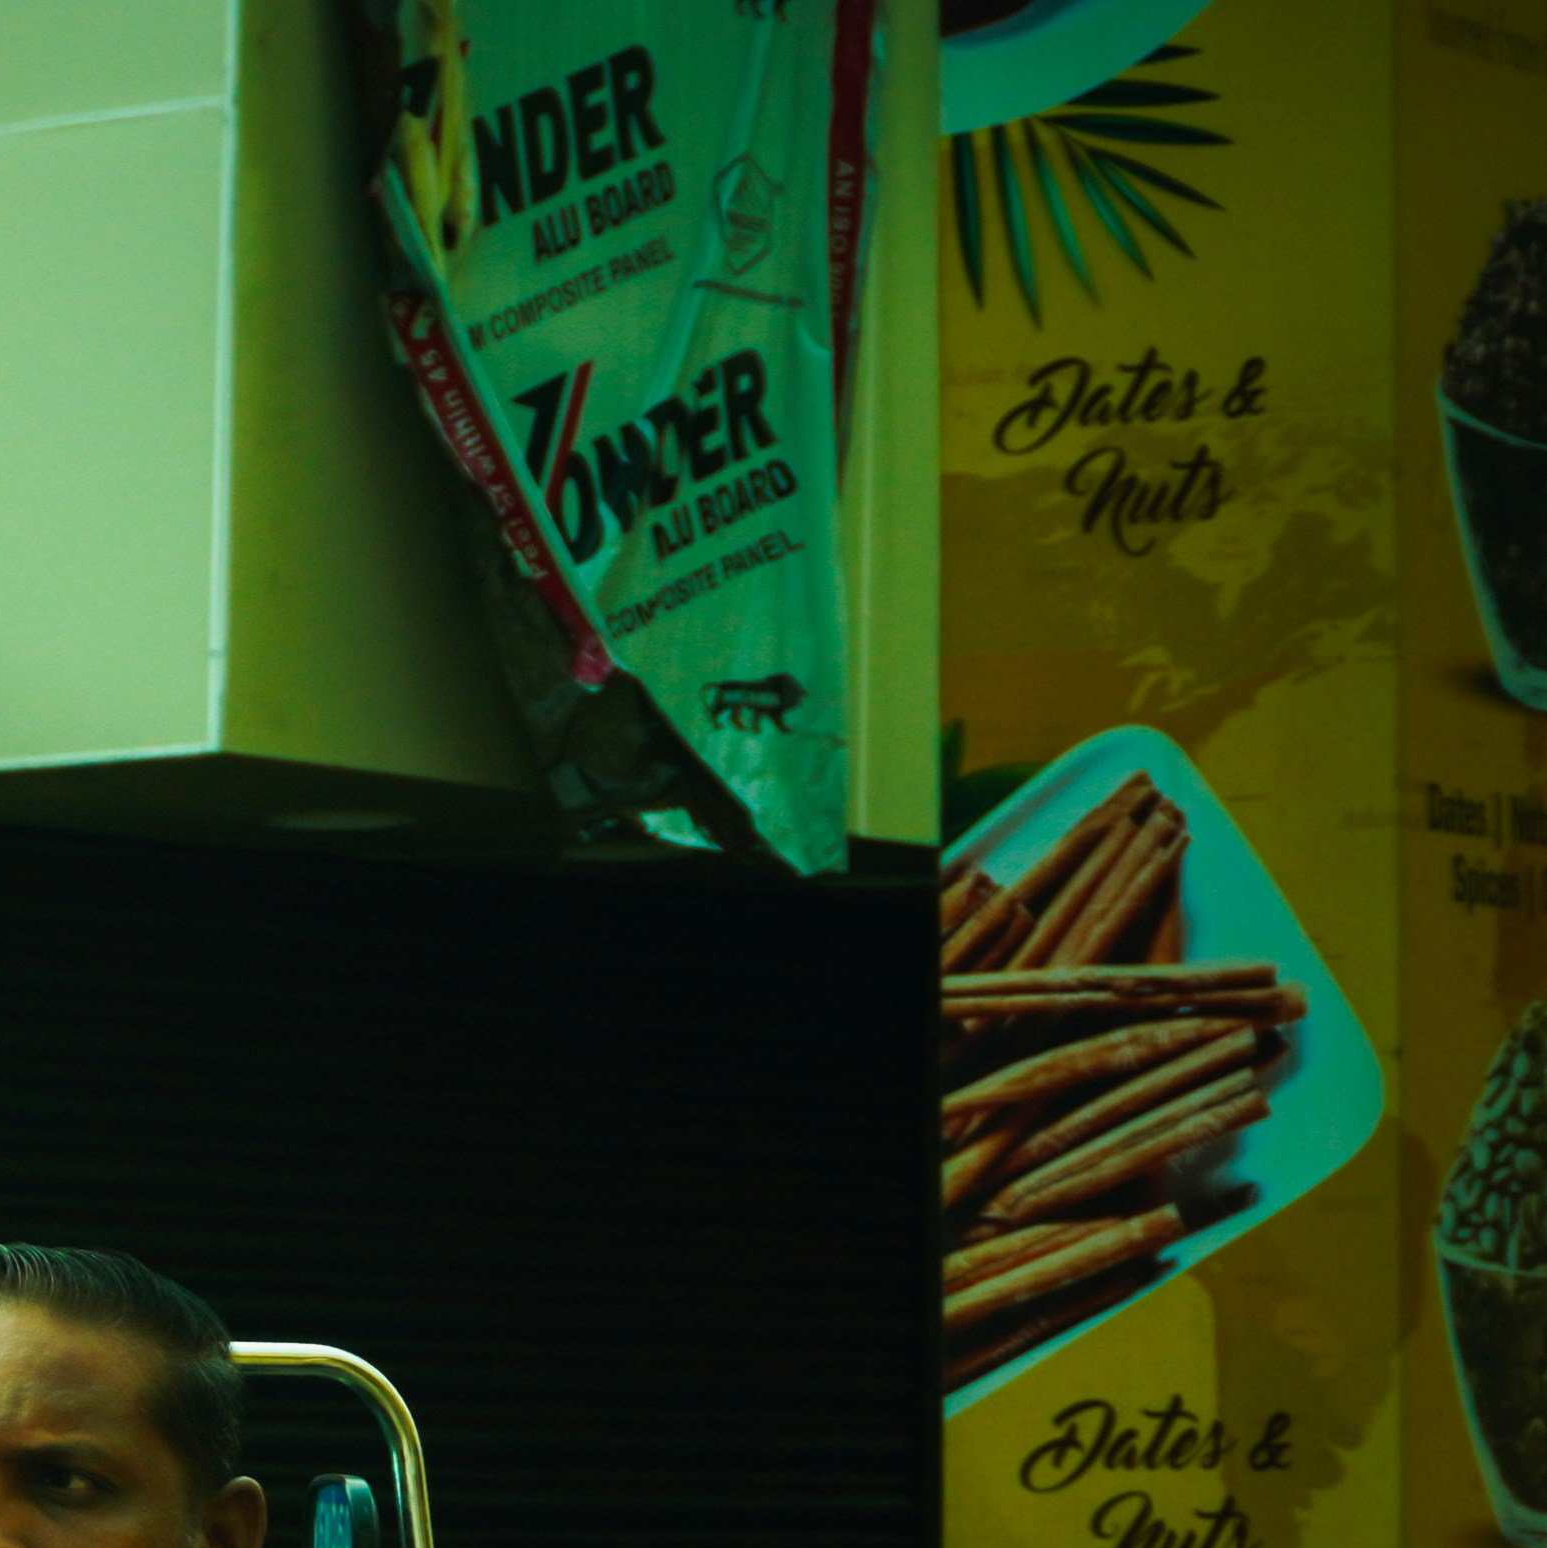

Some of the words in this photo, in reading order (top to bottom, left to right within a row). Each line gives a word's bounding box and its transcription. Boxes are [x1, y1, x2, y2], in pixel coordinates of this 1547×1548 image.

[531, 202, 582, 265] ALU
[586, 162, 678, 241] BOARD
[488, 266, 609, 345] COMPOSITE
[417, 348, 449, 382] 45
[994, 346, 1211, 456] Dates
[1222, 357, 1266, 418] &
[444, 391, 499, 482] within
[702, 459, 798, 541] BOARD
[1065, 444, 1237, 557] Nuts
[719, 530, 805, 578] PANEL
[1020, 1394, 1237, 1493] Dates
[1249, 1411, 1293, 1471] &
